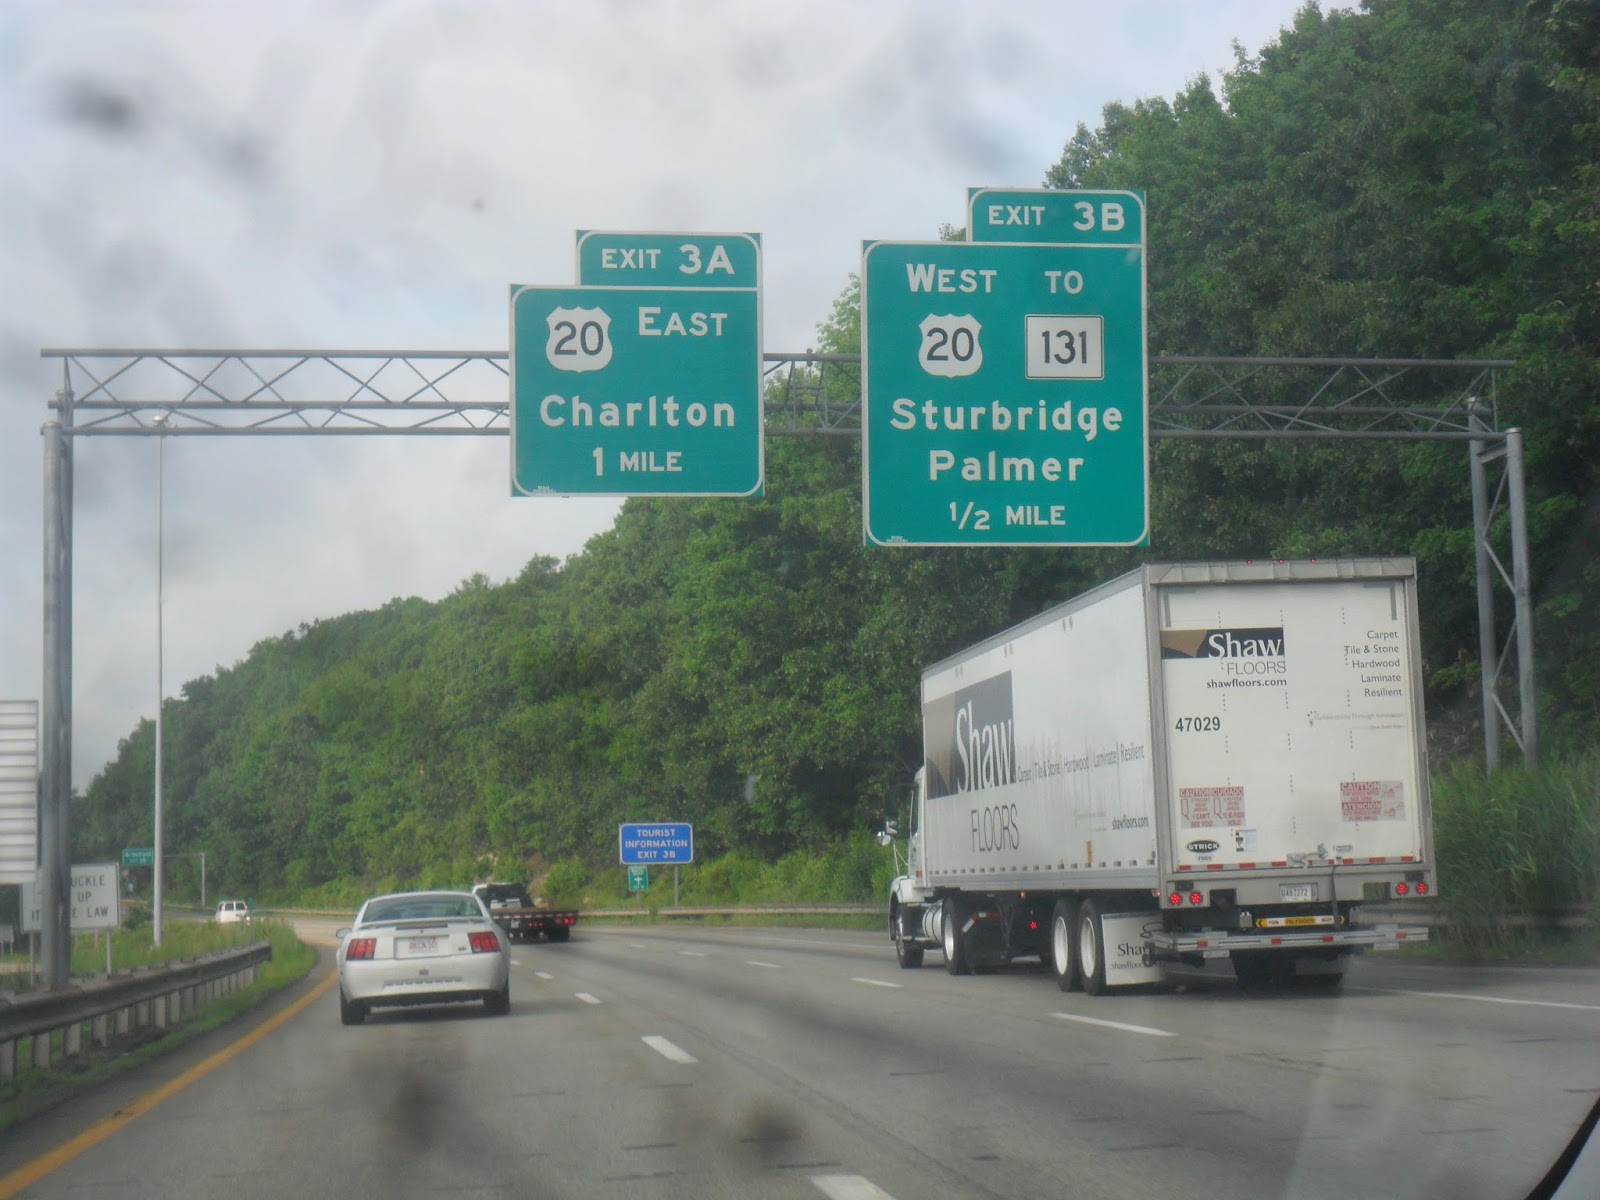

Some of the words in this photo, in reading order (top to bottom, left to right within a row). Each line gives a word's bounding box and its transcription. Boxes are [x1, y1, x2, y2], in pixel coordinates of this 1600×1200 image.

[988, 205, 1046, 226] EXIT
[1073, 201, 1125, 232] 3B
[601, 248, 661, 269] EXIT
[678, 244, 736, 275] 3A
[906, 263, 997, 294] WEST
[1044, 270, 1084, 295] TO
[638, 306, 728, 337] EAST
[553, 320, 604, 356] 20
[926, 327, 974, 362] 20
[1041, 329, 1088, 365] 131
[539, 394, 735, 428] Charlton
[889, 398, 1123, 442] Sturbridge
[592, 447, 604, 477] 1
[619, 451, 683, 472] MILE
[929, 449, 1084, 482] Palmer
[949, 501, 990, 531] 1/2
[1005, 505, 1066, 526] MILE
[1366, 630, 1399, 642] Carpet
[1208, 632, 1282, 658] Shaw
[1343, 644, 1361, 655] Tile
[1363, 645, 1371, 654] &
[1373, 643, 1400, 654] Stone
[1226, 661, 1287, 676] FLOORS
[1351, 658, 1401, 669] Hardwood
[1206, 677, 1288, 690] shawfloors.com
[1360, 673, 1402, 684] Laminate
[1363, 687, 1403, 698] Resilient
[1175, 715, 1222, 732] 47029
[956, 700, 1012, 792] Shaw
[1064, 756, 1090, 773] Hardwood
[1120, 743, 1145, 762] Resilient
[1341, 781, 1380, 791] CAUTION
[1342, 801, 1381, 811] ATENCION
[970, 802, 1020, 853] FLOORS
[1111, 813, 1150, 831] shawfloors.com
[636, 828, 676, 837] TOURIST
[625, 840, 688, 849] INFORMATION
[1188, 842, 1219, 851] STRICK
[637, 851, 658, 859] EXIT
[663, 850, 676, 859] 3B
[71, 874, 105, 887] UCKLE
[77, 890, 92, 903] UP
[87, 906, 109, 918] LAW
